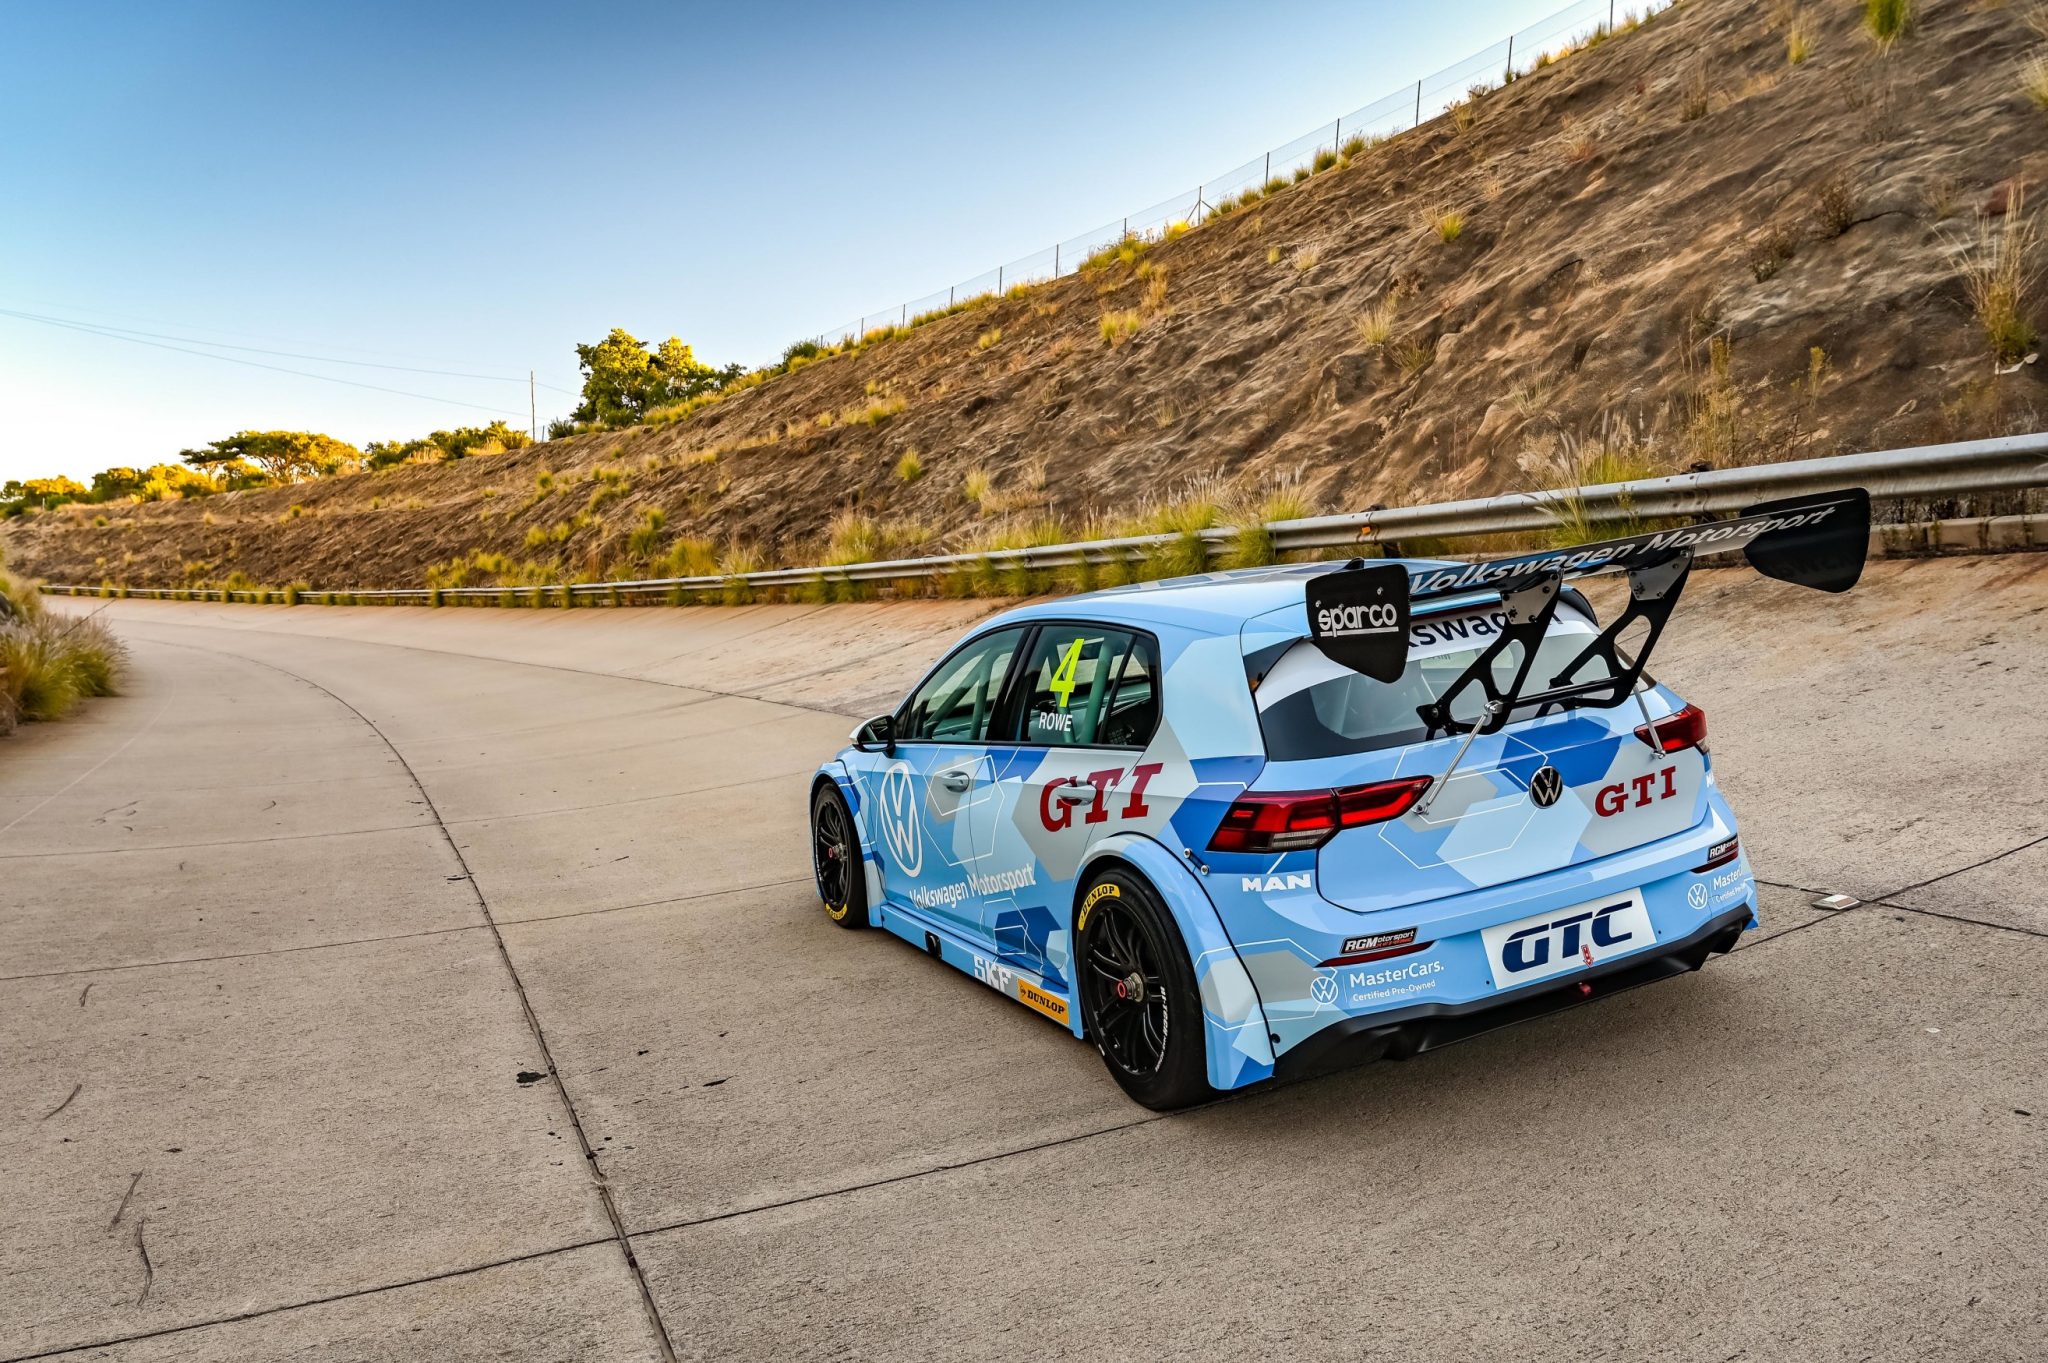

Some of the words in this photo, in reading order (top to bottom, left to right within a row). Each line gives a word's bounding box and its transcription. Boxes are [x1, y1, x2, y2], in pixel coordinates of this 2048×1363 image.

[1410, 543, 1635, 594] Volkswagen
[1636, 506, 1836, 555] Motorsport
[1318, 603, 1398, 638] sparco
[1050, 638, 1085, 708] 4
[1038, 711, 1073, 732] ROWE
[1040, 763, 1164, 832] GTI
[1595, 766, 1677, 817] GTI
[909, 880, 969, 909] Volkswagen
[967, 863, 1036, 896] Motorsport
[1082, 885, 1115, 915] DUNLOP
[1241, 873, 1311, 892] MAN
[1502, 900, 1632, 973] GTC
[974, 954, 1012, 993] SKF
[1350, 960, 1445, 988] MasterCars.
[1352, 988, 1389, 1002] Certified
[1392, 980, 1436, 997] Pre-Owned
[1027, 990, 1065, 1014] DUNLOP
